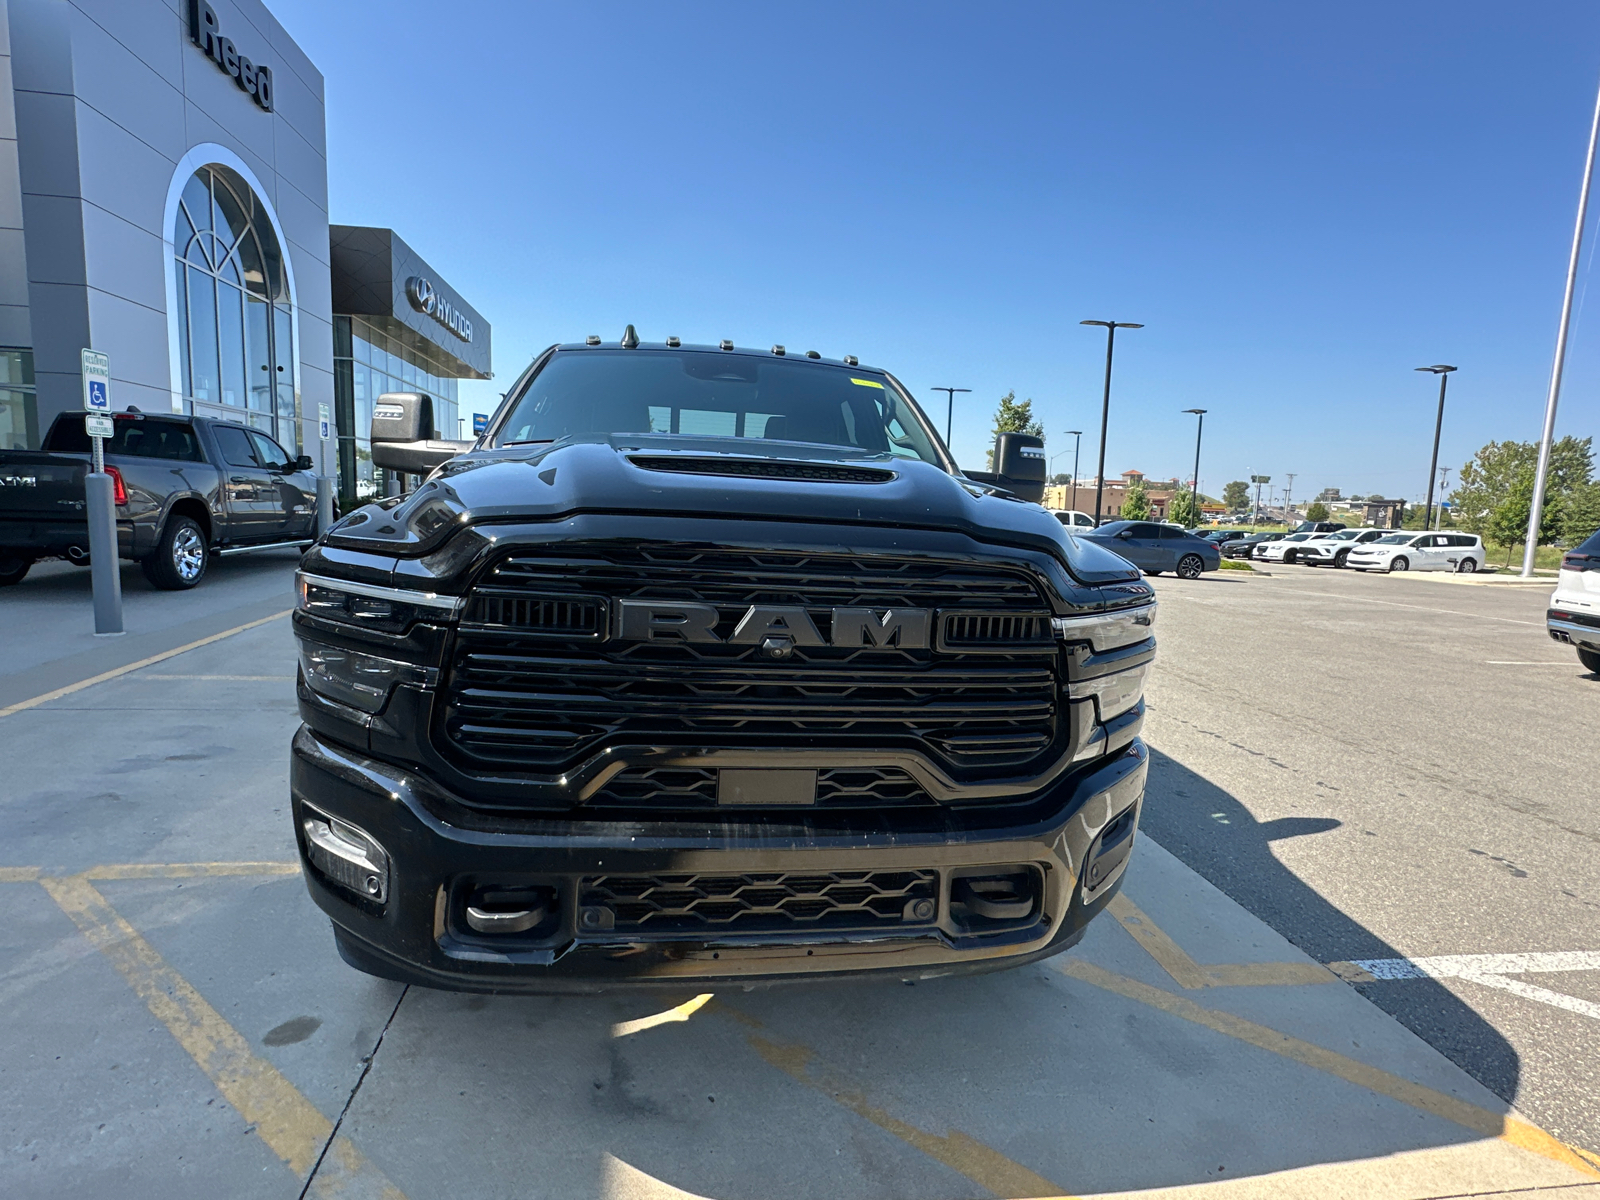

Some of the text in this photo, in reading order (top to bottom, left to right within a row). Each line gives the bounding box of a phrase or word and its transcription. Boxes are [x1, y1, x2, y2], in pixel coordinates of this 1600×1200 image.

[189, 0, 274, 113] Reed
[437, 294, 473, 343] HYUNDAI
[618, 599, 930, 648] RAM
